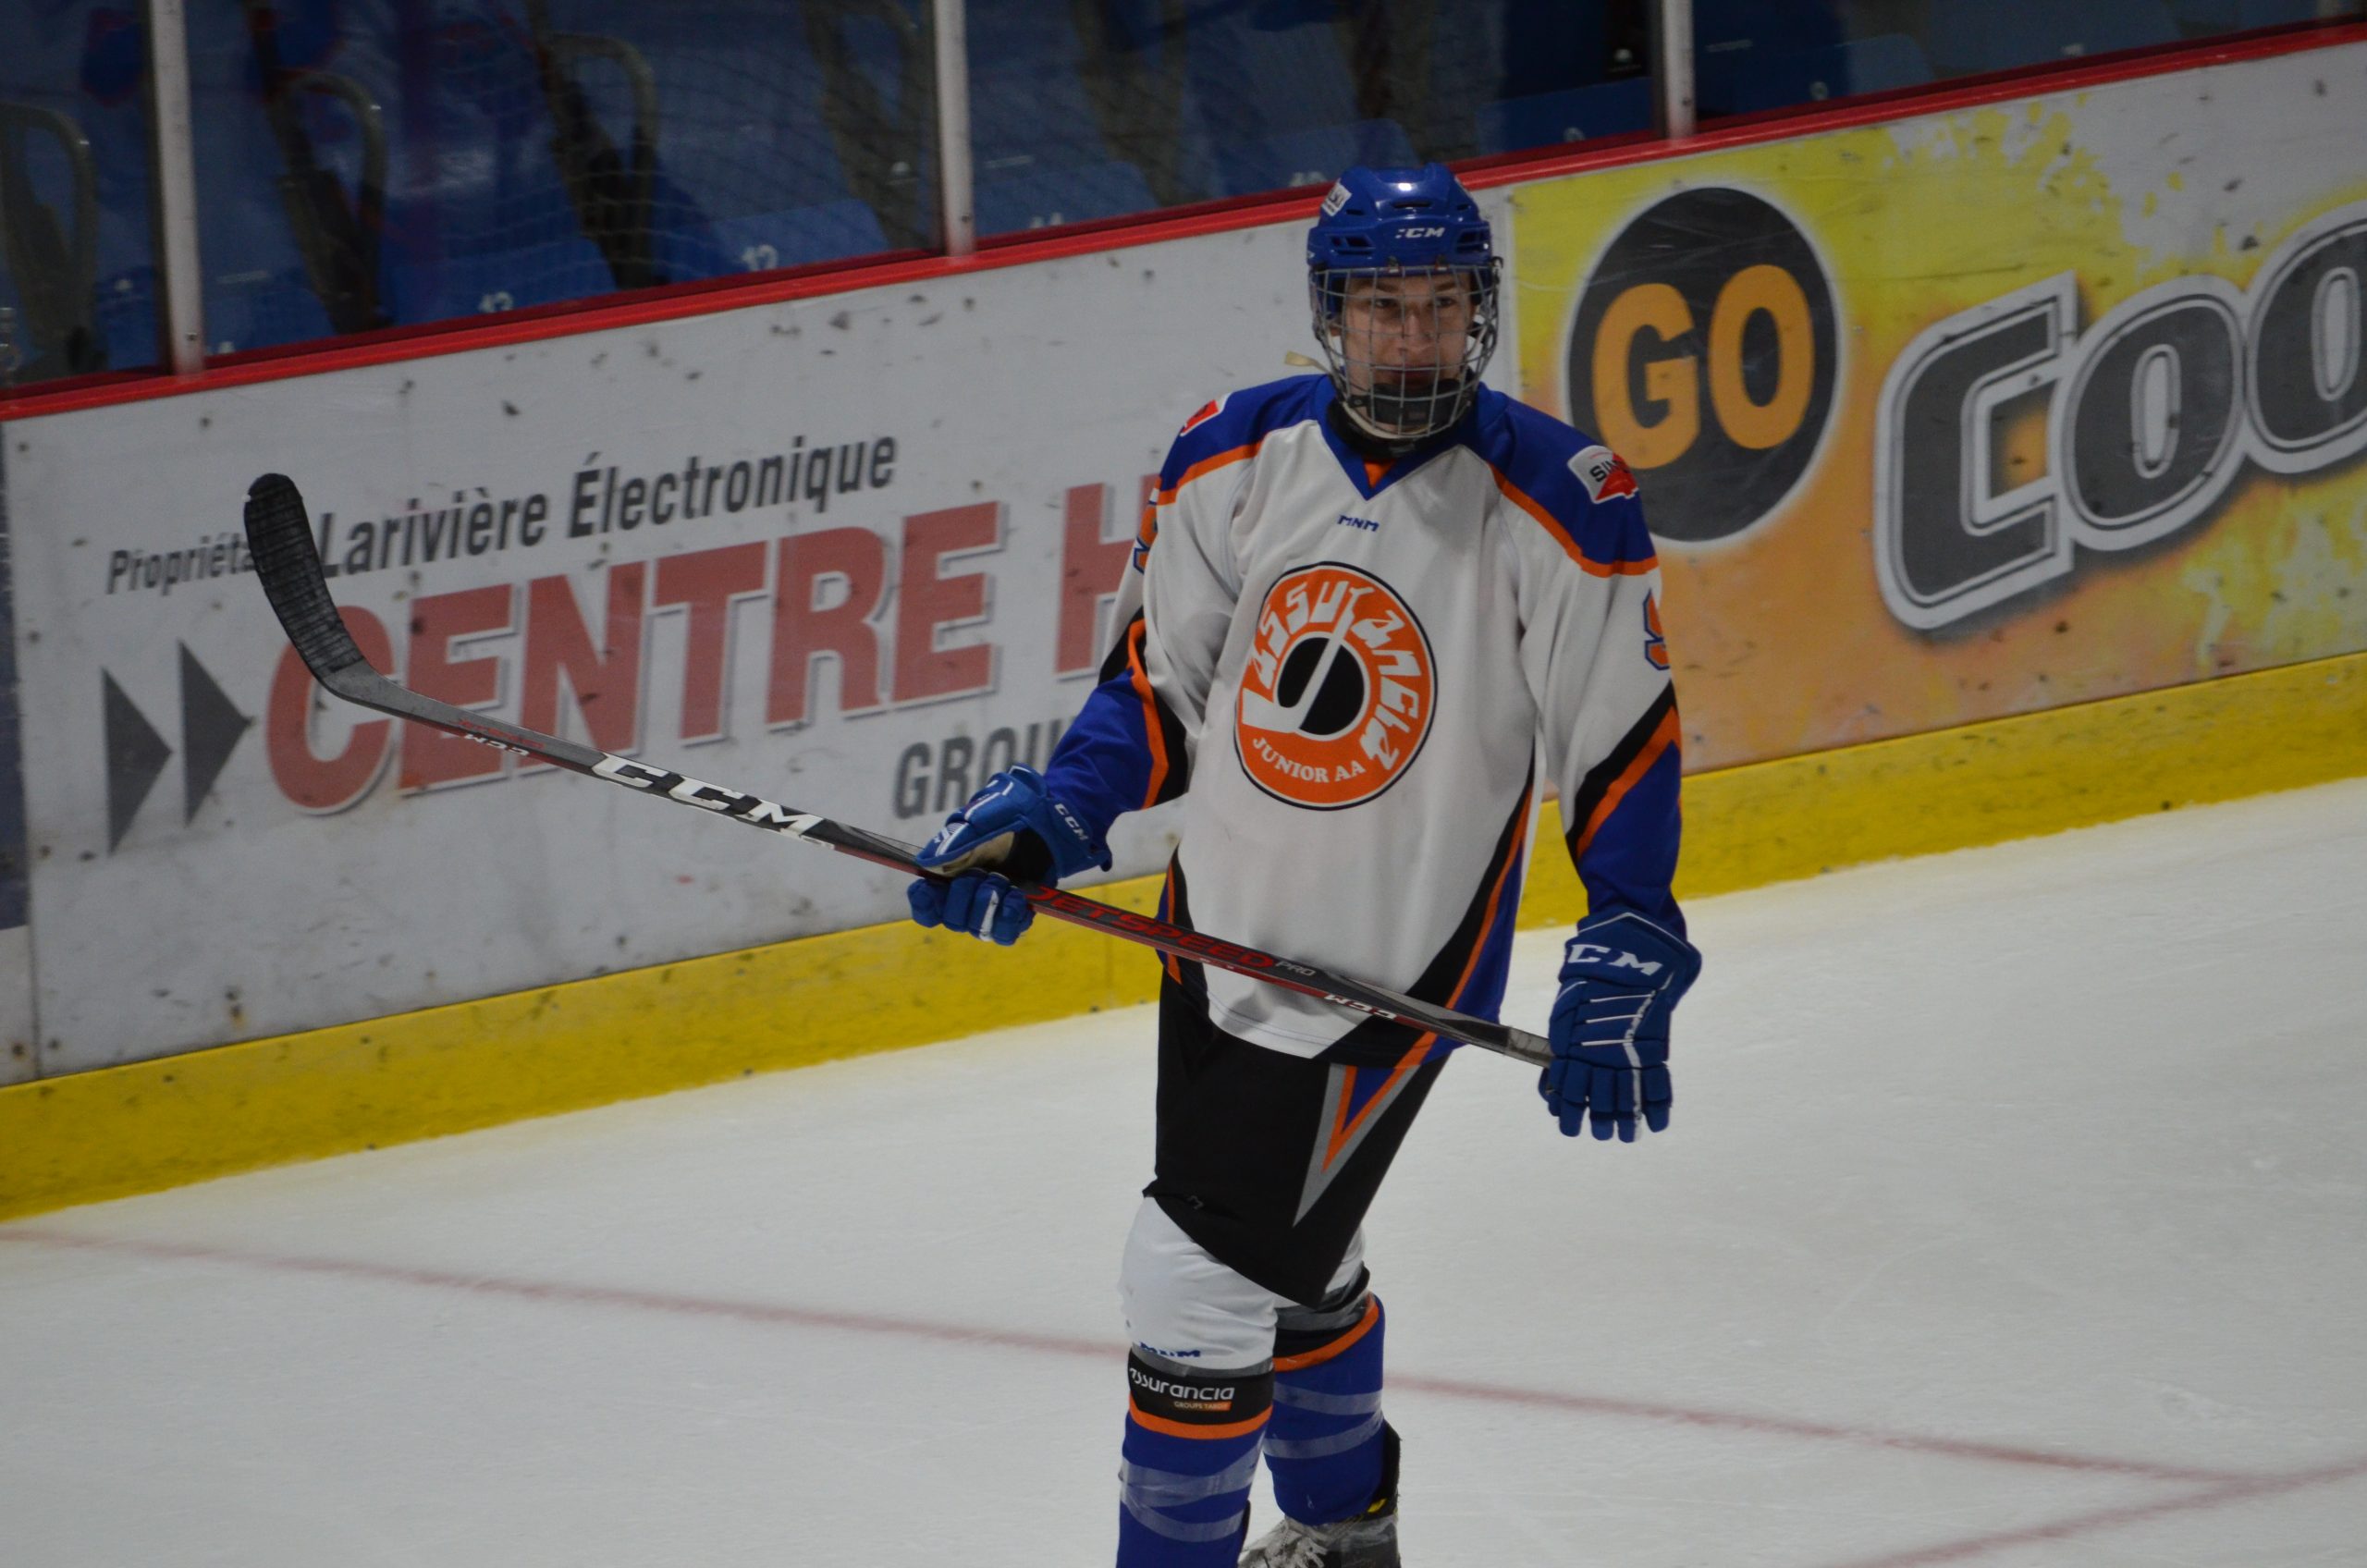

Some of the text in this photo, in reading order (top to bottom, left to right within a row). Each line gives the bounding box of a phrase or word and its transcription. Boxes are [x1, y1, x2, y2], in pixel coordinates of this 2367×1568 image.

[1591, 264, 1815, 470] GO
[319, 485, 548, 580] Larivière
[566, 435, 896, 540] Électronique
[1337, 514, 1380, 533] MNM
[266, 500, 1004, 815] CENTRE
[592, 753, 825, 835] CCM
[1253, 737, 1367, 783] JUNIOR AA
[1053, 802, 1090, 842] CCM
[1025, 886, 1317, 977] JETSPEED PRO
